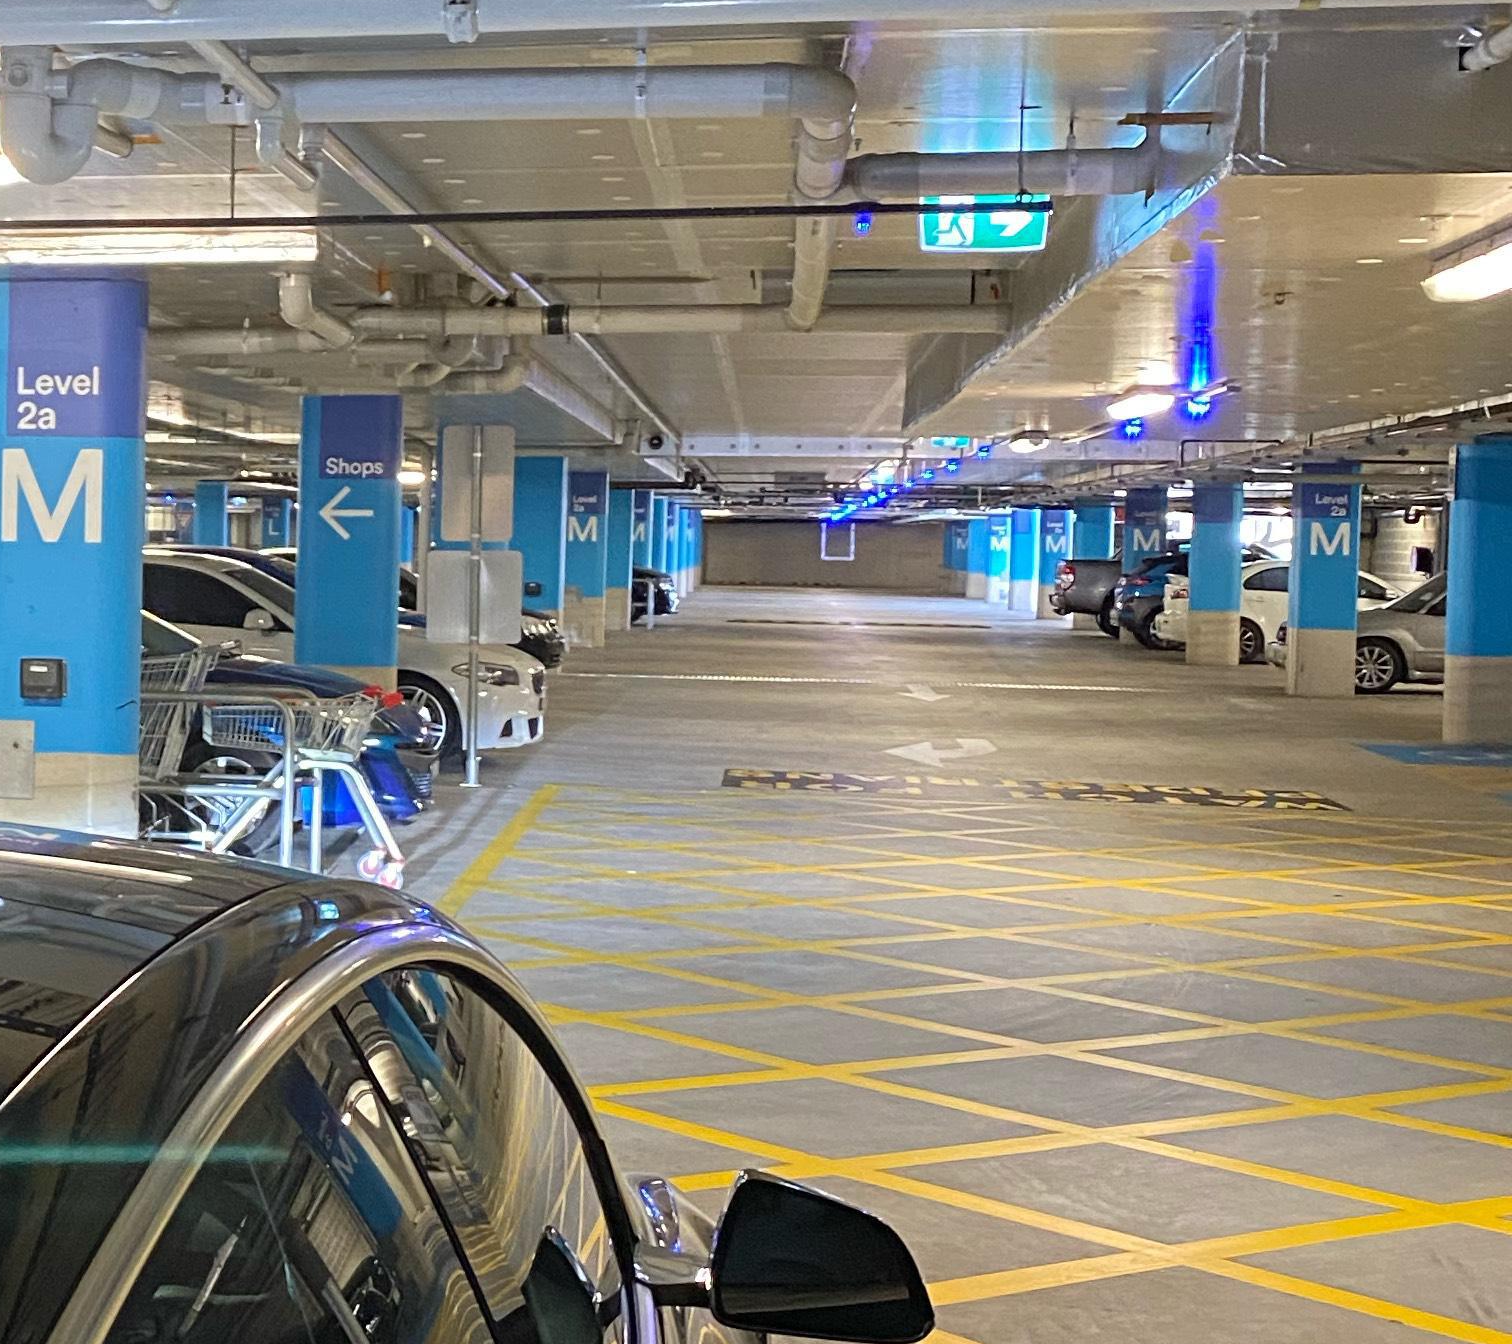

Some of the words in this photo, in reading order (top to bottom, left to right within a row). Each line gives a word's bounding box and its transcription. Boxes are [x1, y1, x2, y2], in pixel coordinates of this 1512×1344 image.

[17, 366, 100, 396] Level
[17, 401, 56, 430] 2a
[326, 457, 384, 478] Shops
[0, 448, 103, 543] M
[1315, 493, 1348, 504] Level
[1330, 506, 1348, 516] 2a
[269, 519, 280, 535] L
[567, 516, 598, 542] M
[990, 536, 1008, 552] M
[1045, 535, 1067, 554] M
[1133, 528, 1161, 552] M
[1310, 522, 1351, 556] M
[1009, 790, 1345, 811] WATCH
